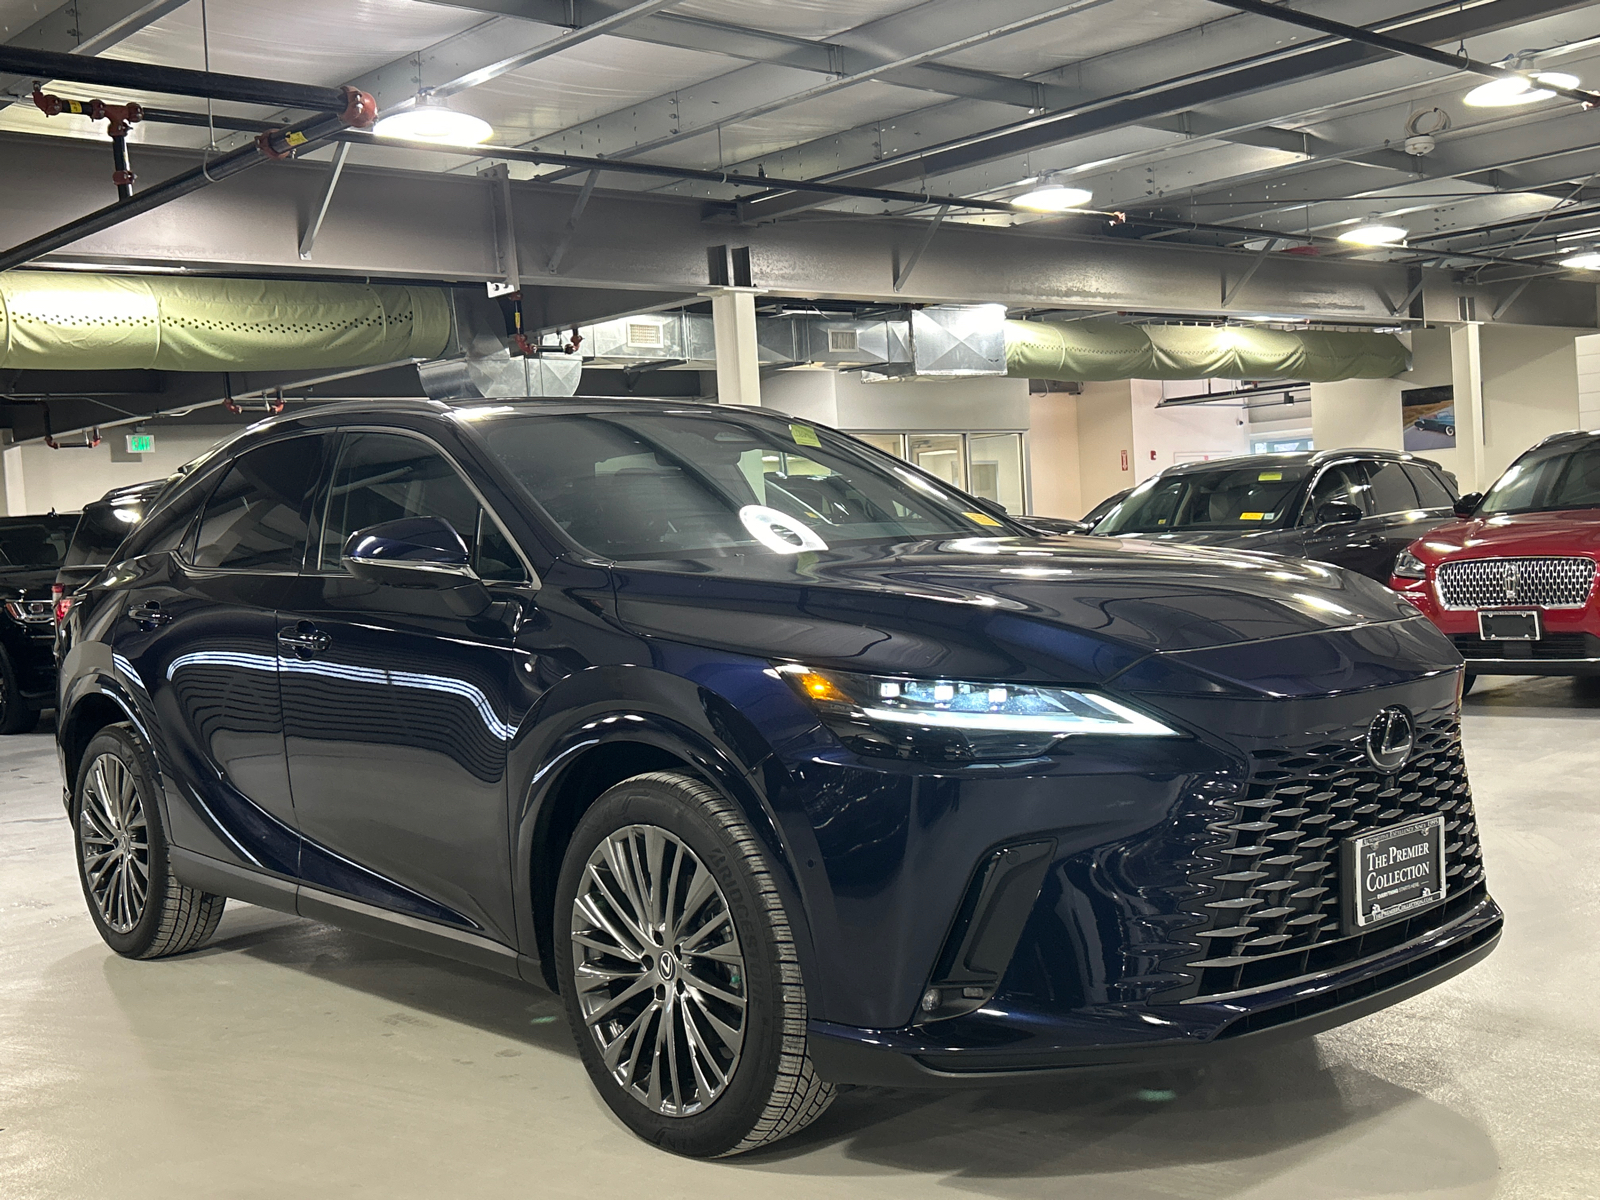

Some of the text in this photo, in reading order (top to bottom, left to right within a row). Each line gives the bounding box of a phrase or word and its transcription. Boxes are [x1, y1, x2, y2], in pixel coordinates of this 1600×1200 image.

[131, 436, 150, 451] EXIT
[1366, 842, 1430, 871] THE PREMIER
[1366, 861, 1430, 892] COLLECTION
